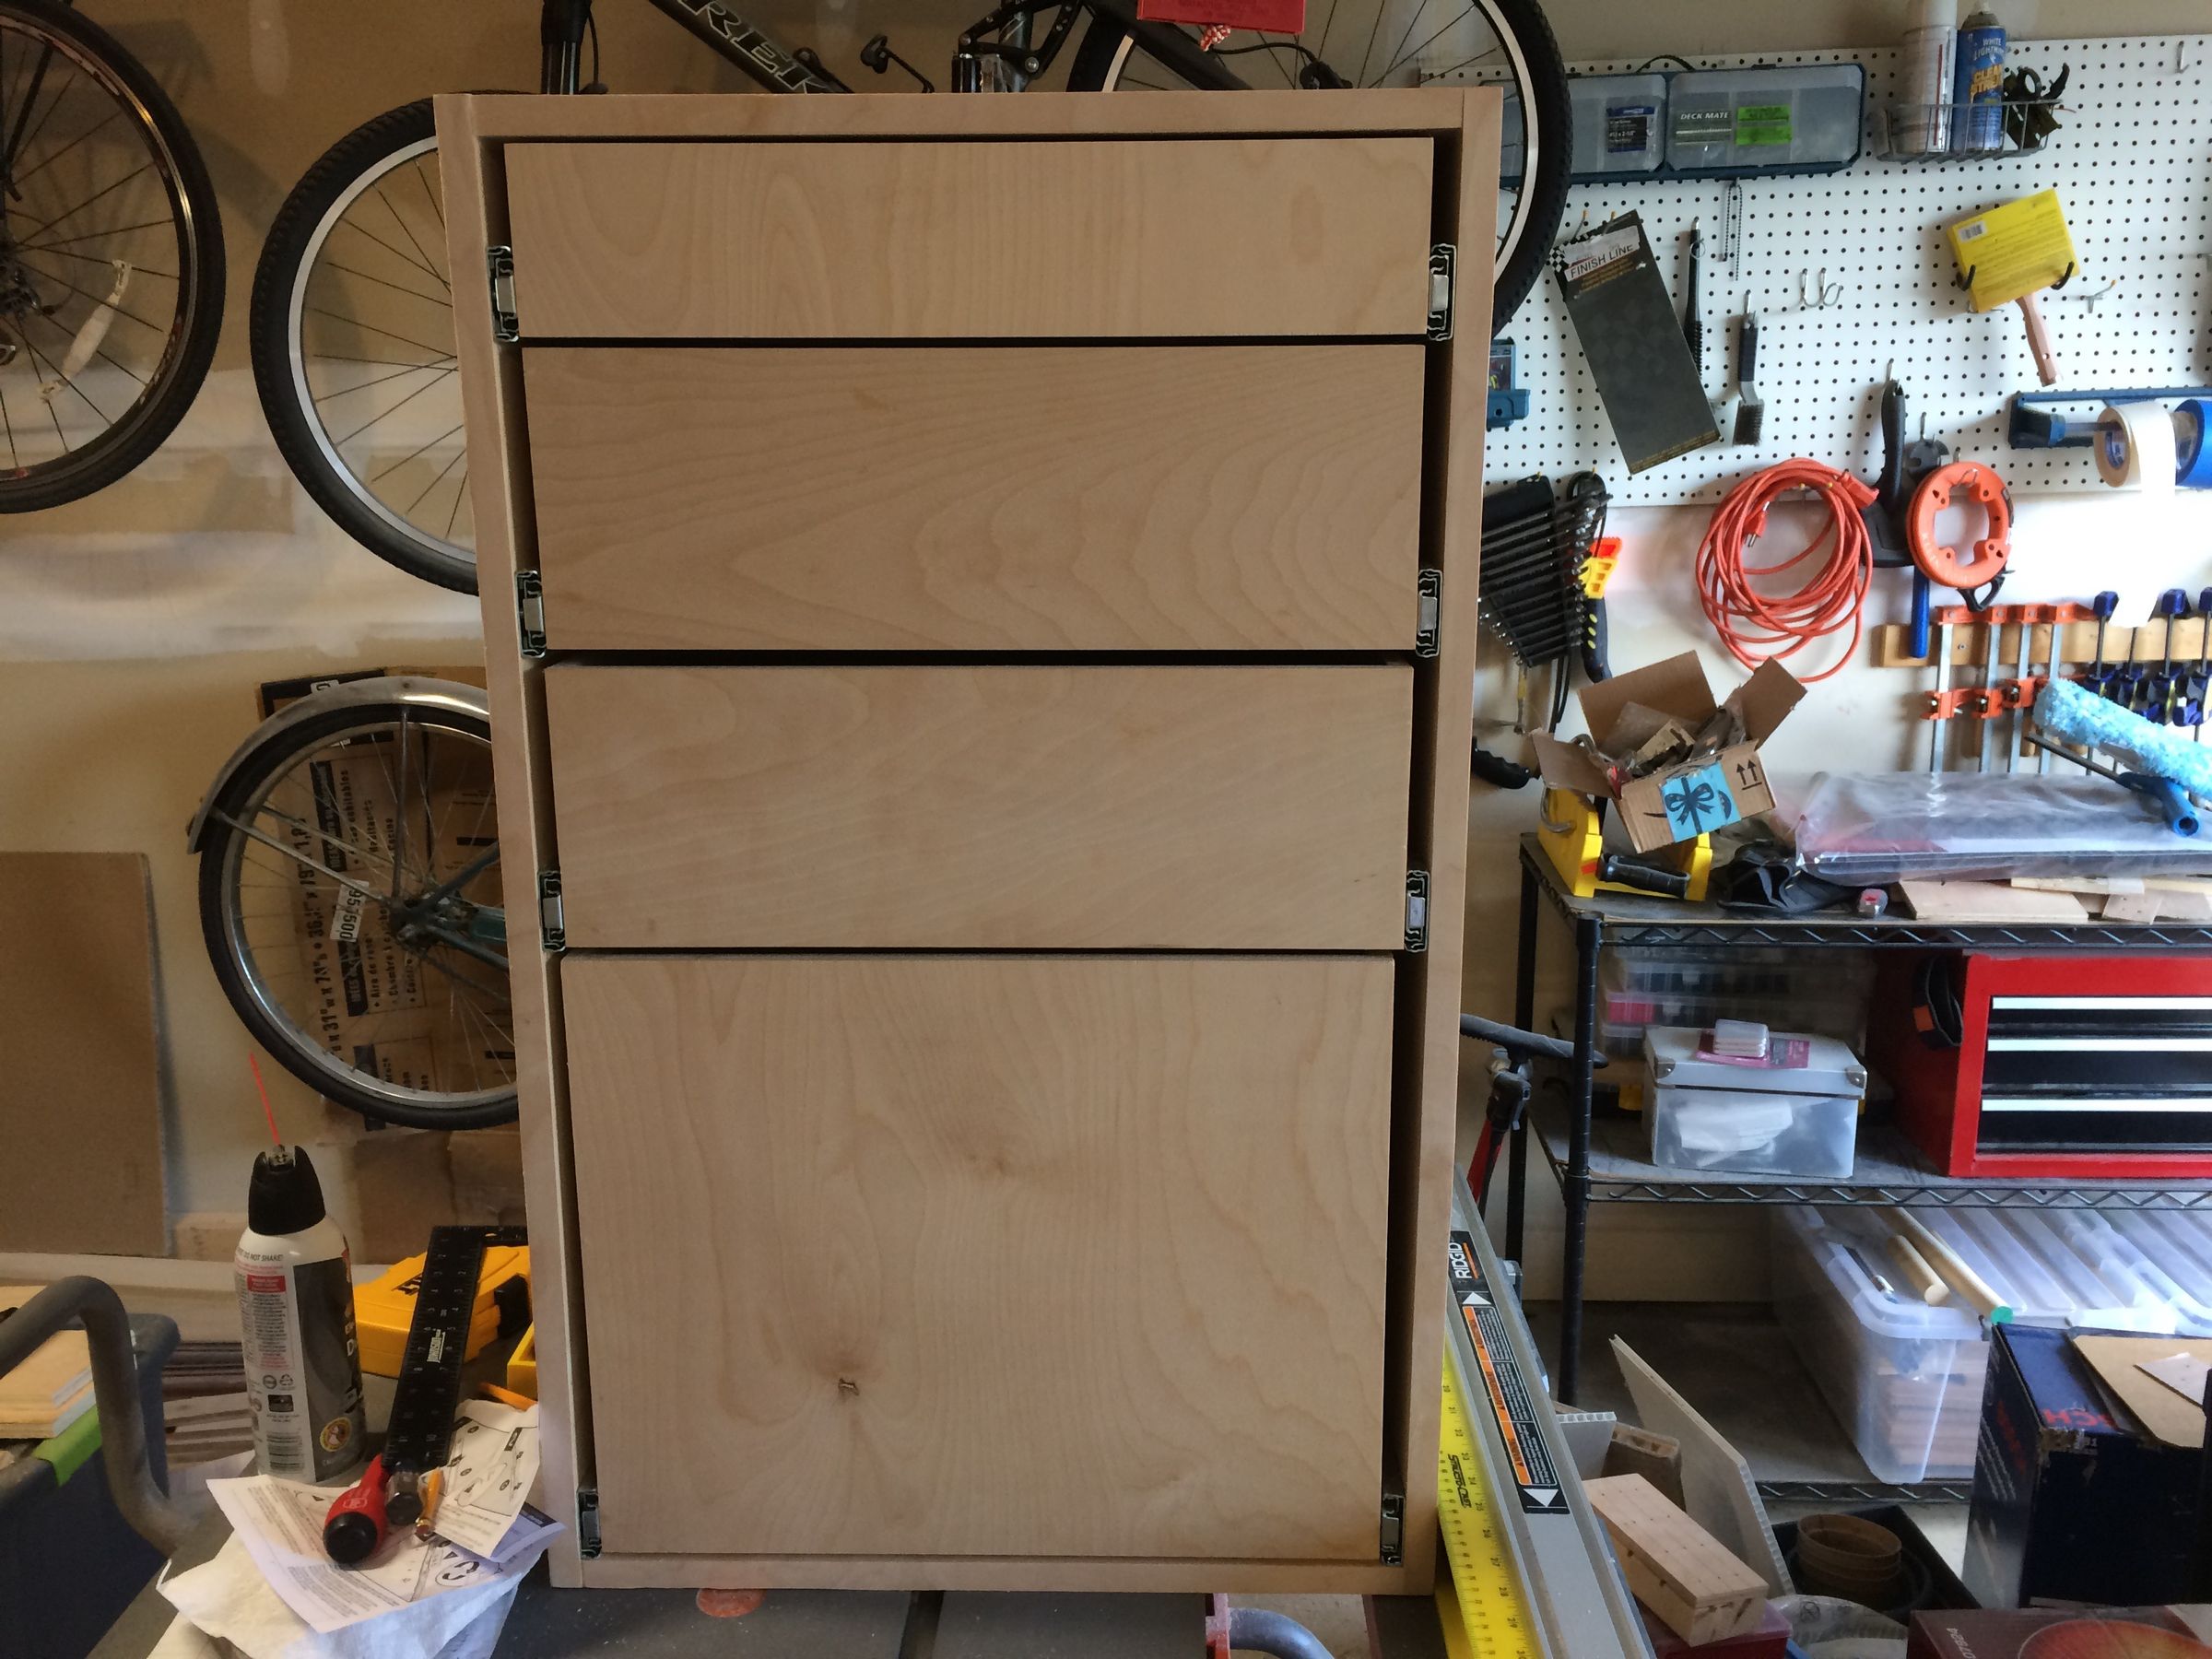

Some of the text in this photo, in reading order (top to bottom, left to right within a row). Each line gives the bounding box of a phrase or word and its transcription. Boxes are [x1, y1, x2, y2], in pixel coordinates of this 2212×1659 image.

[1680, 112, 1702, 120] DECK
[1704, 112, 1729, 120] MATE
[1571, 253, 1606, 278] FINISH
[1608, 244, 1634, 261] LINE
[1448, 1241, 1473, 1279] RIDGID
